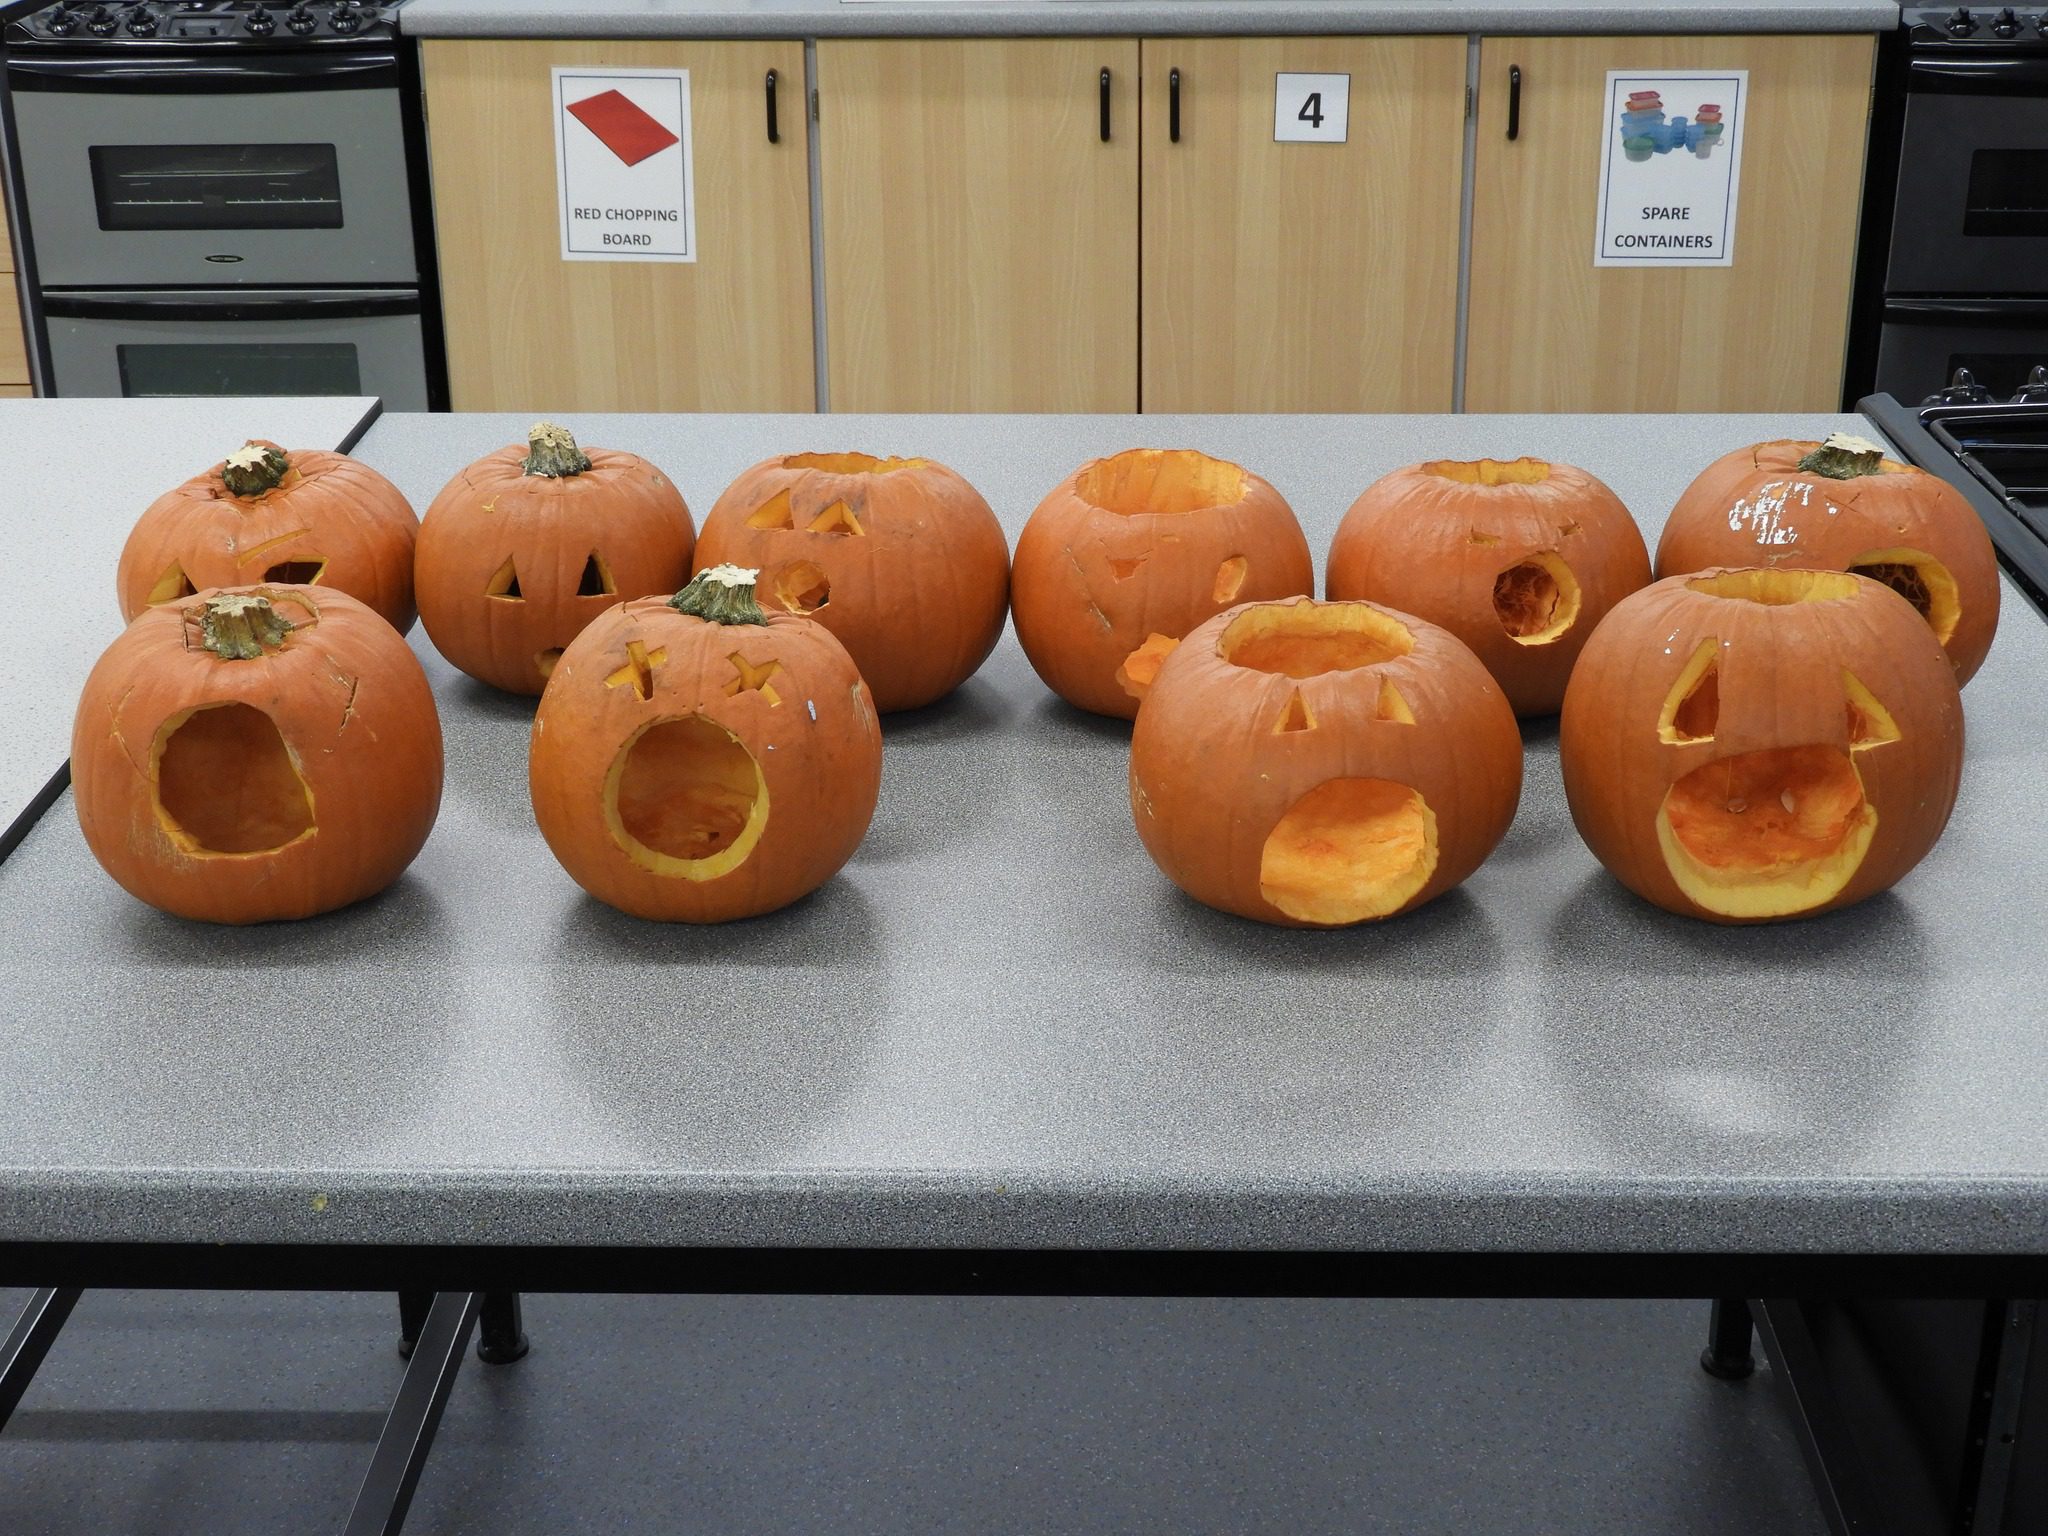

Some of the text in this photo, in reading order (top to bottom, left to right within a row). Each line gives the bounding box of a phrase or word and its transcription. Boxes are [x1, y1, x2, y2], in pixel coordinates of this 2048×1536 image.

[1298, 92, 1325, 128] 4
[574, 208, 678, 222] RED CHOPPING
[1641, 206, 1691, 220] SPARE
[603, 233, 652, 246] BOARD
[1614, 234, 1713, 249] CONTAINERS
